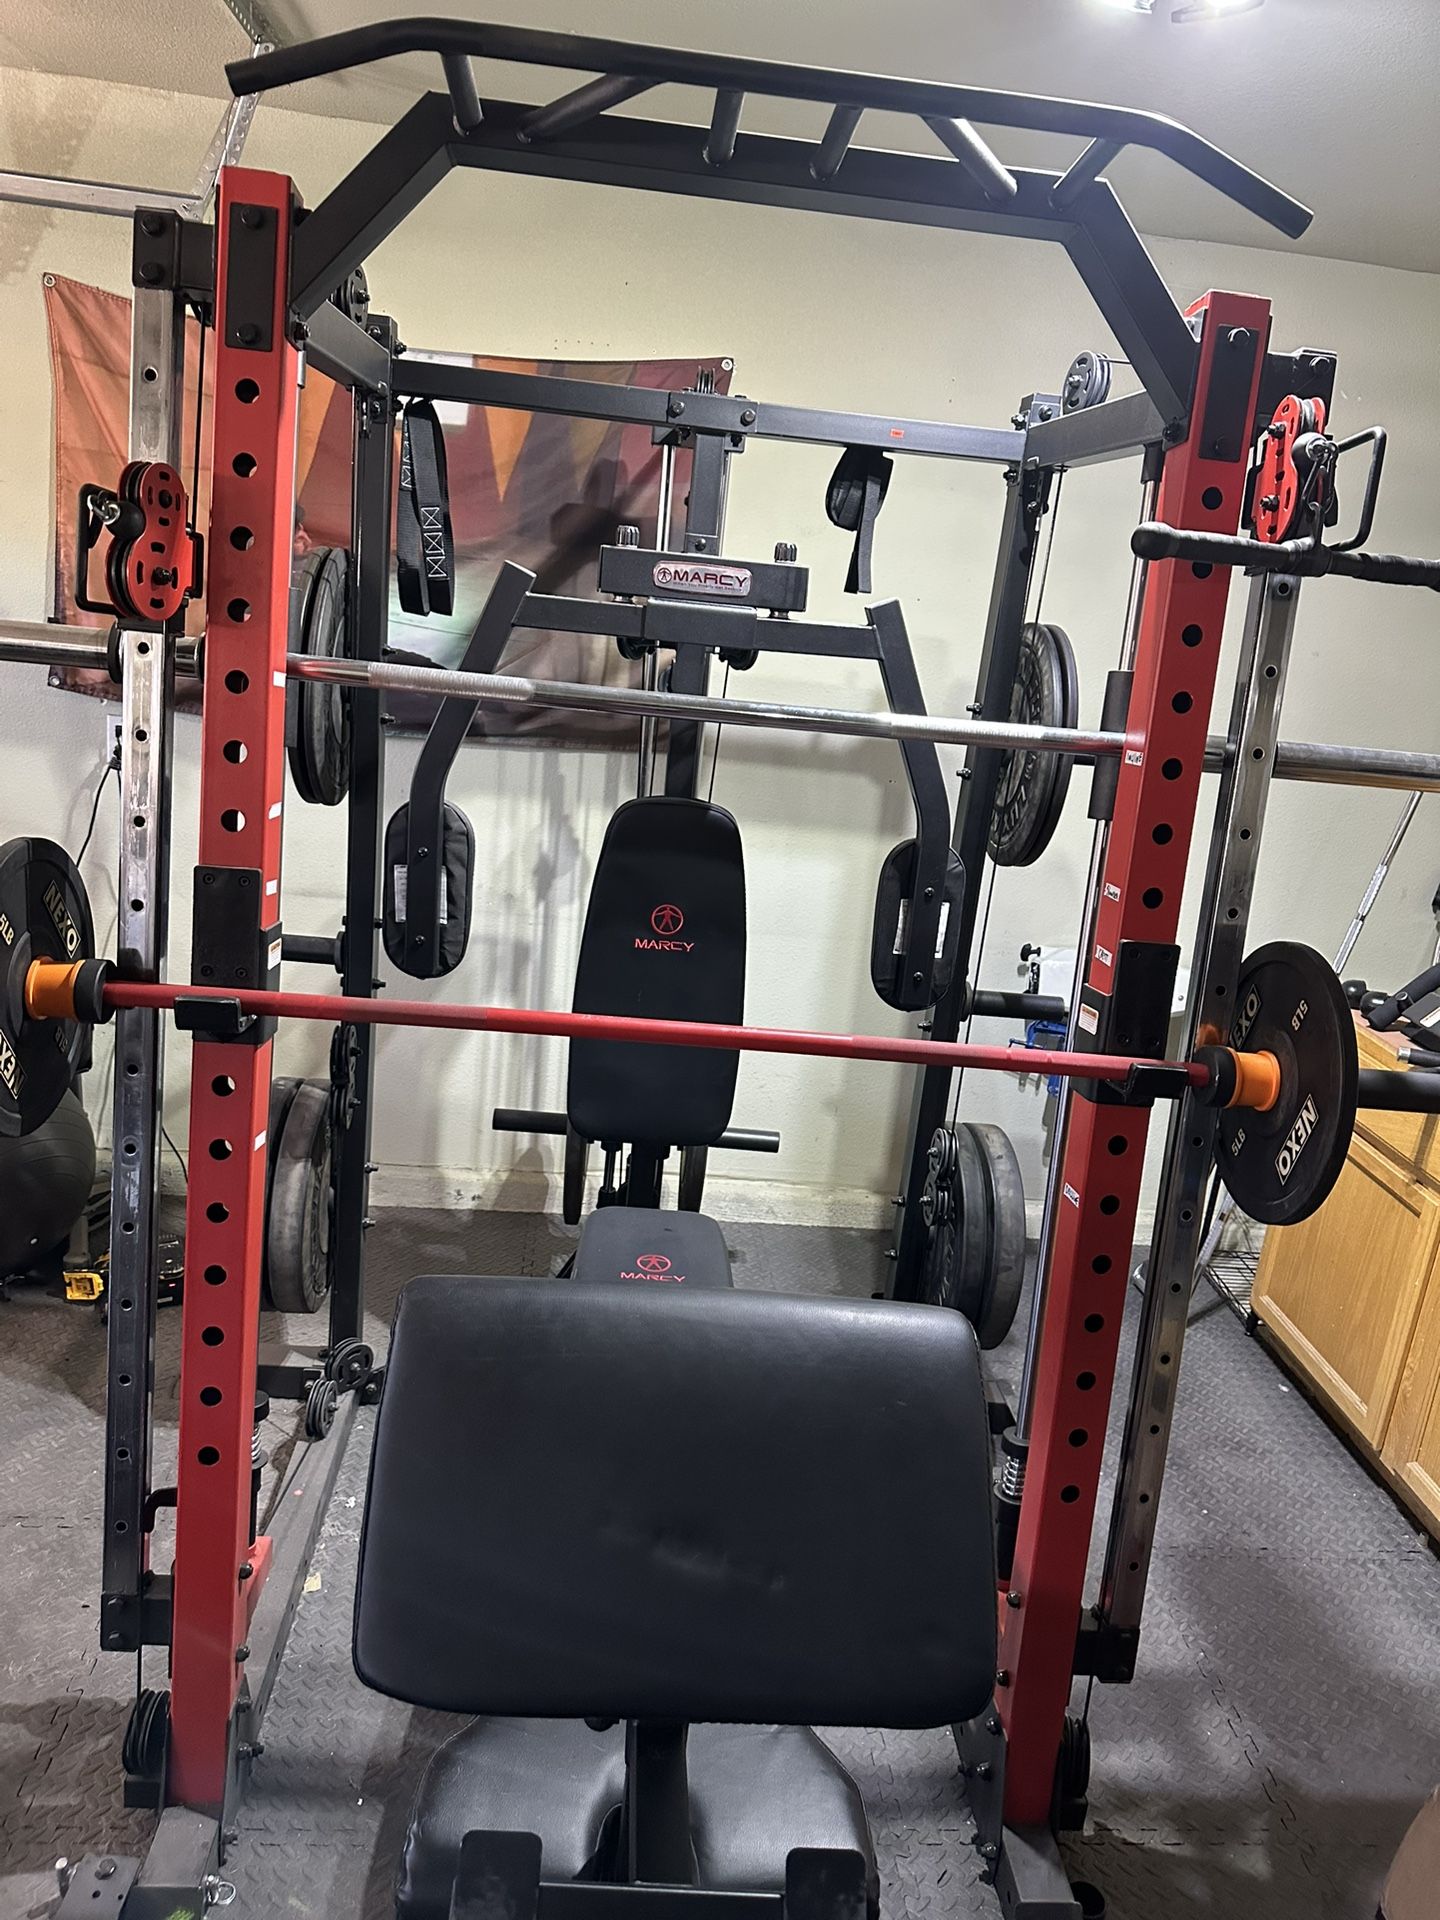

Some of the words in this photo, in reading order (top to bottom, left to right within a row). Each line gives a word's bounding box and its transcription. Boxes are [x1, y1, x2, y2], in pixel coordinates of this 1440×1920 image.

[673, 569, 748, 588] MARCY
[46, 884, 78, 952] NEXO
[634, 938, 695, 952] MARCY
[1230, 993, 1258, 1048] EXO
[1291, 999, 1309, 1031] 5LB
[0, 1033, 25, 1095] NEX
[1231, 1127, 1246, 1157] 5LB
[1278, 1099, 1318, 1177] NEXO
[620, 1271, 686, 1282] MARCY
